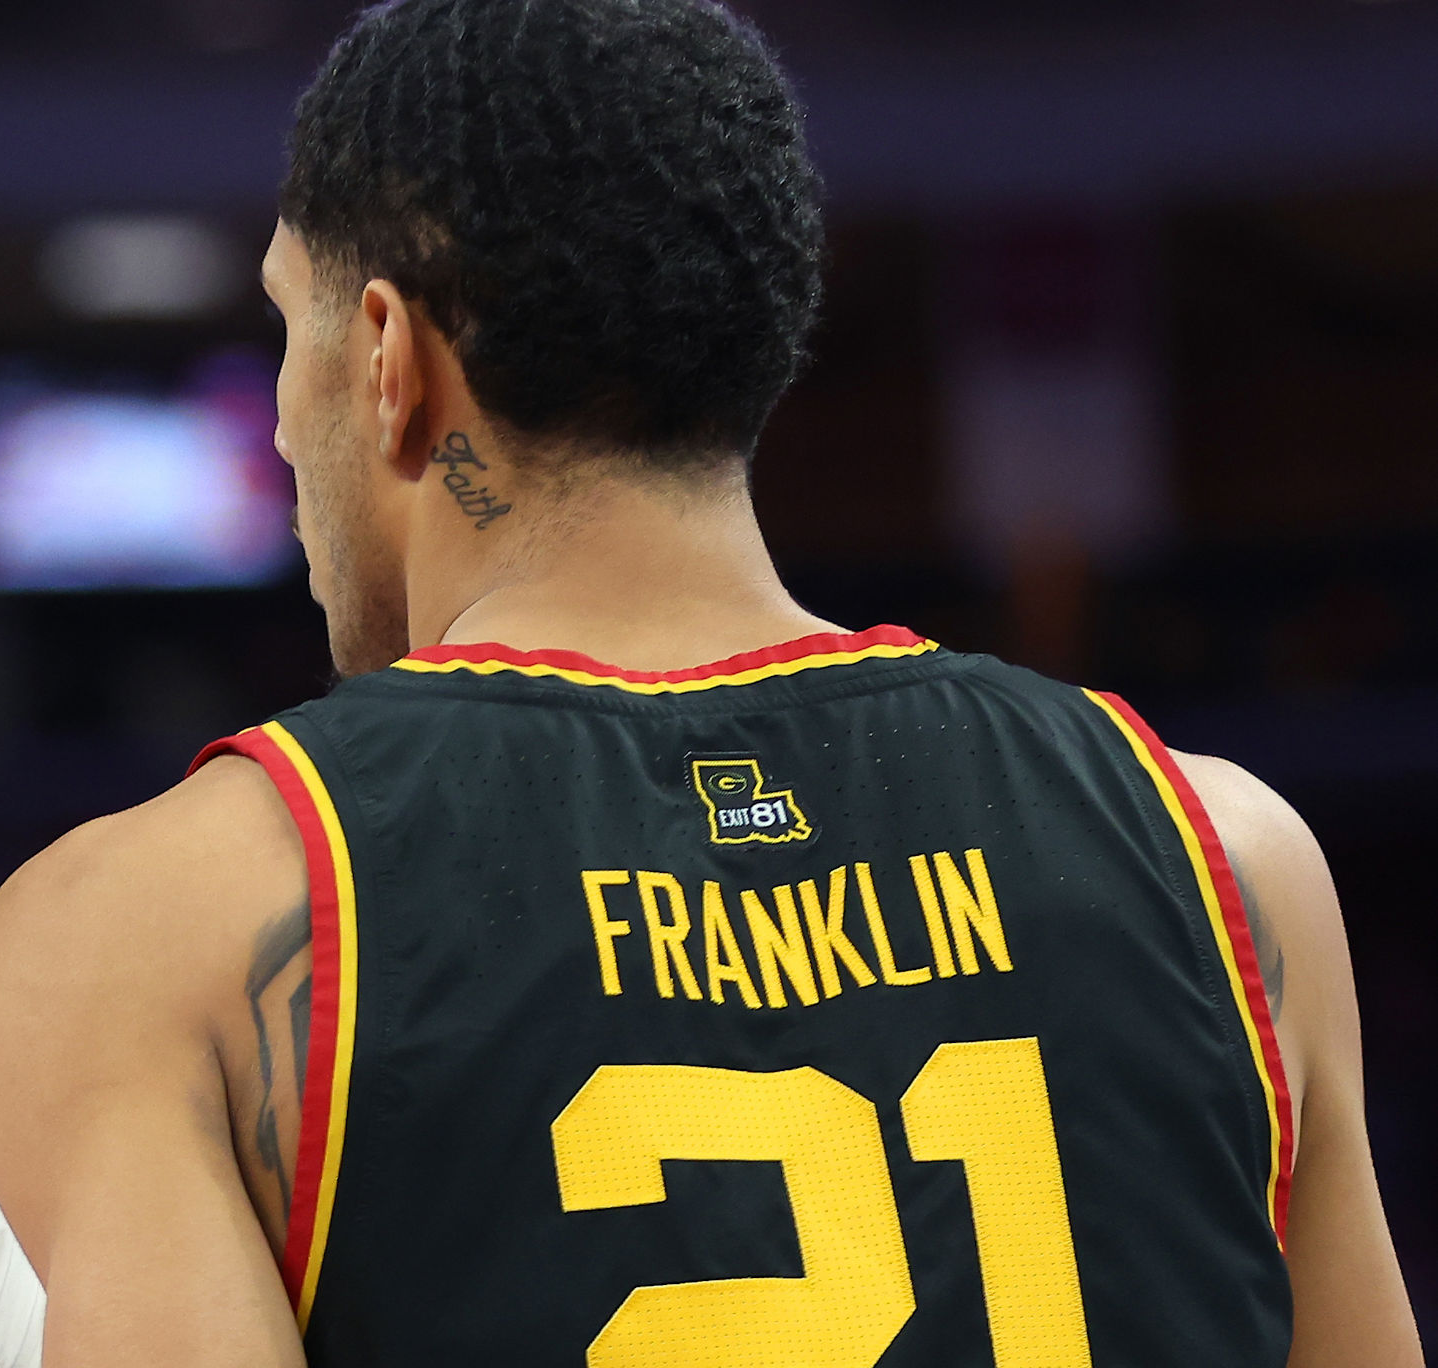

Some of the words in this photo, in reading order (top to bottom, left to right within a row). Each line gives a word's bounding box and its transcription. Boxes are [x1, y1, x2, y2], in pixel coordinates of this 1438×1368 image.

[430, 431, 512, 530] Faith
[718, 808, 750, 828] EXIT
[750, 800, 788, 827] 81
[580, 847, 1013, 1010] FRANKLIN
